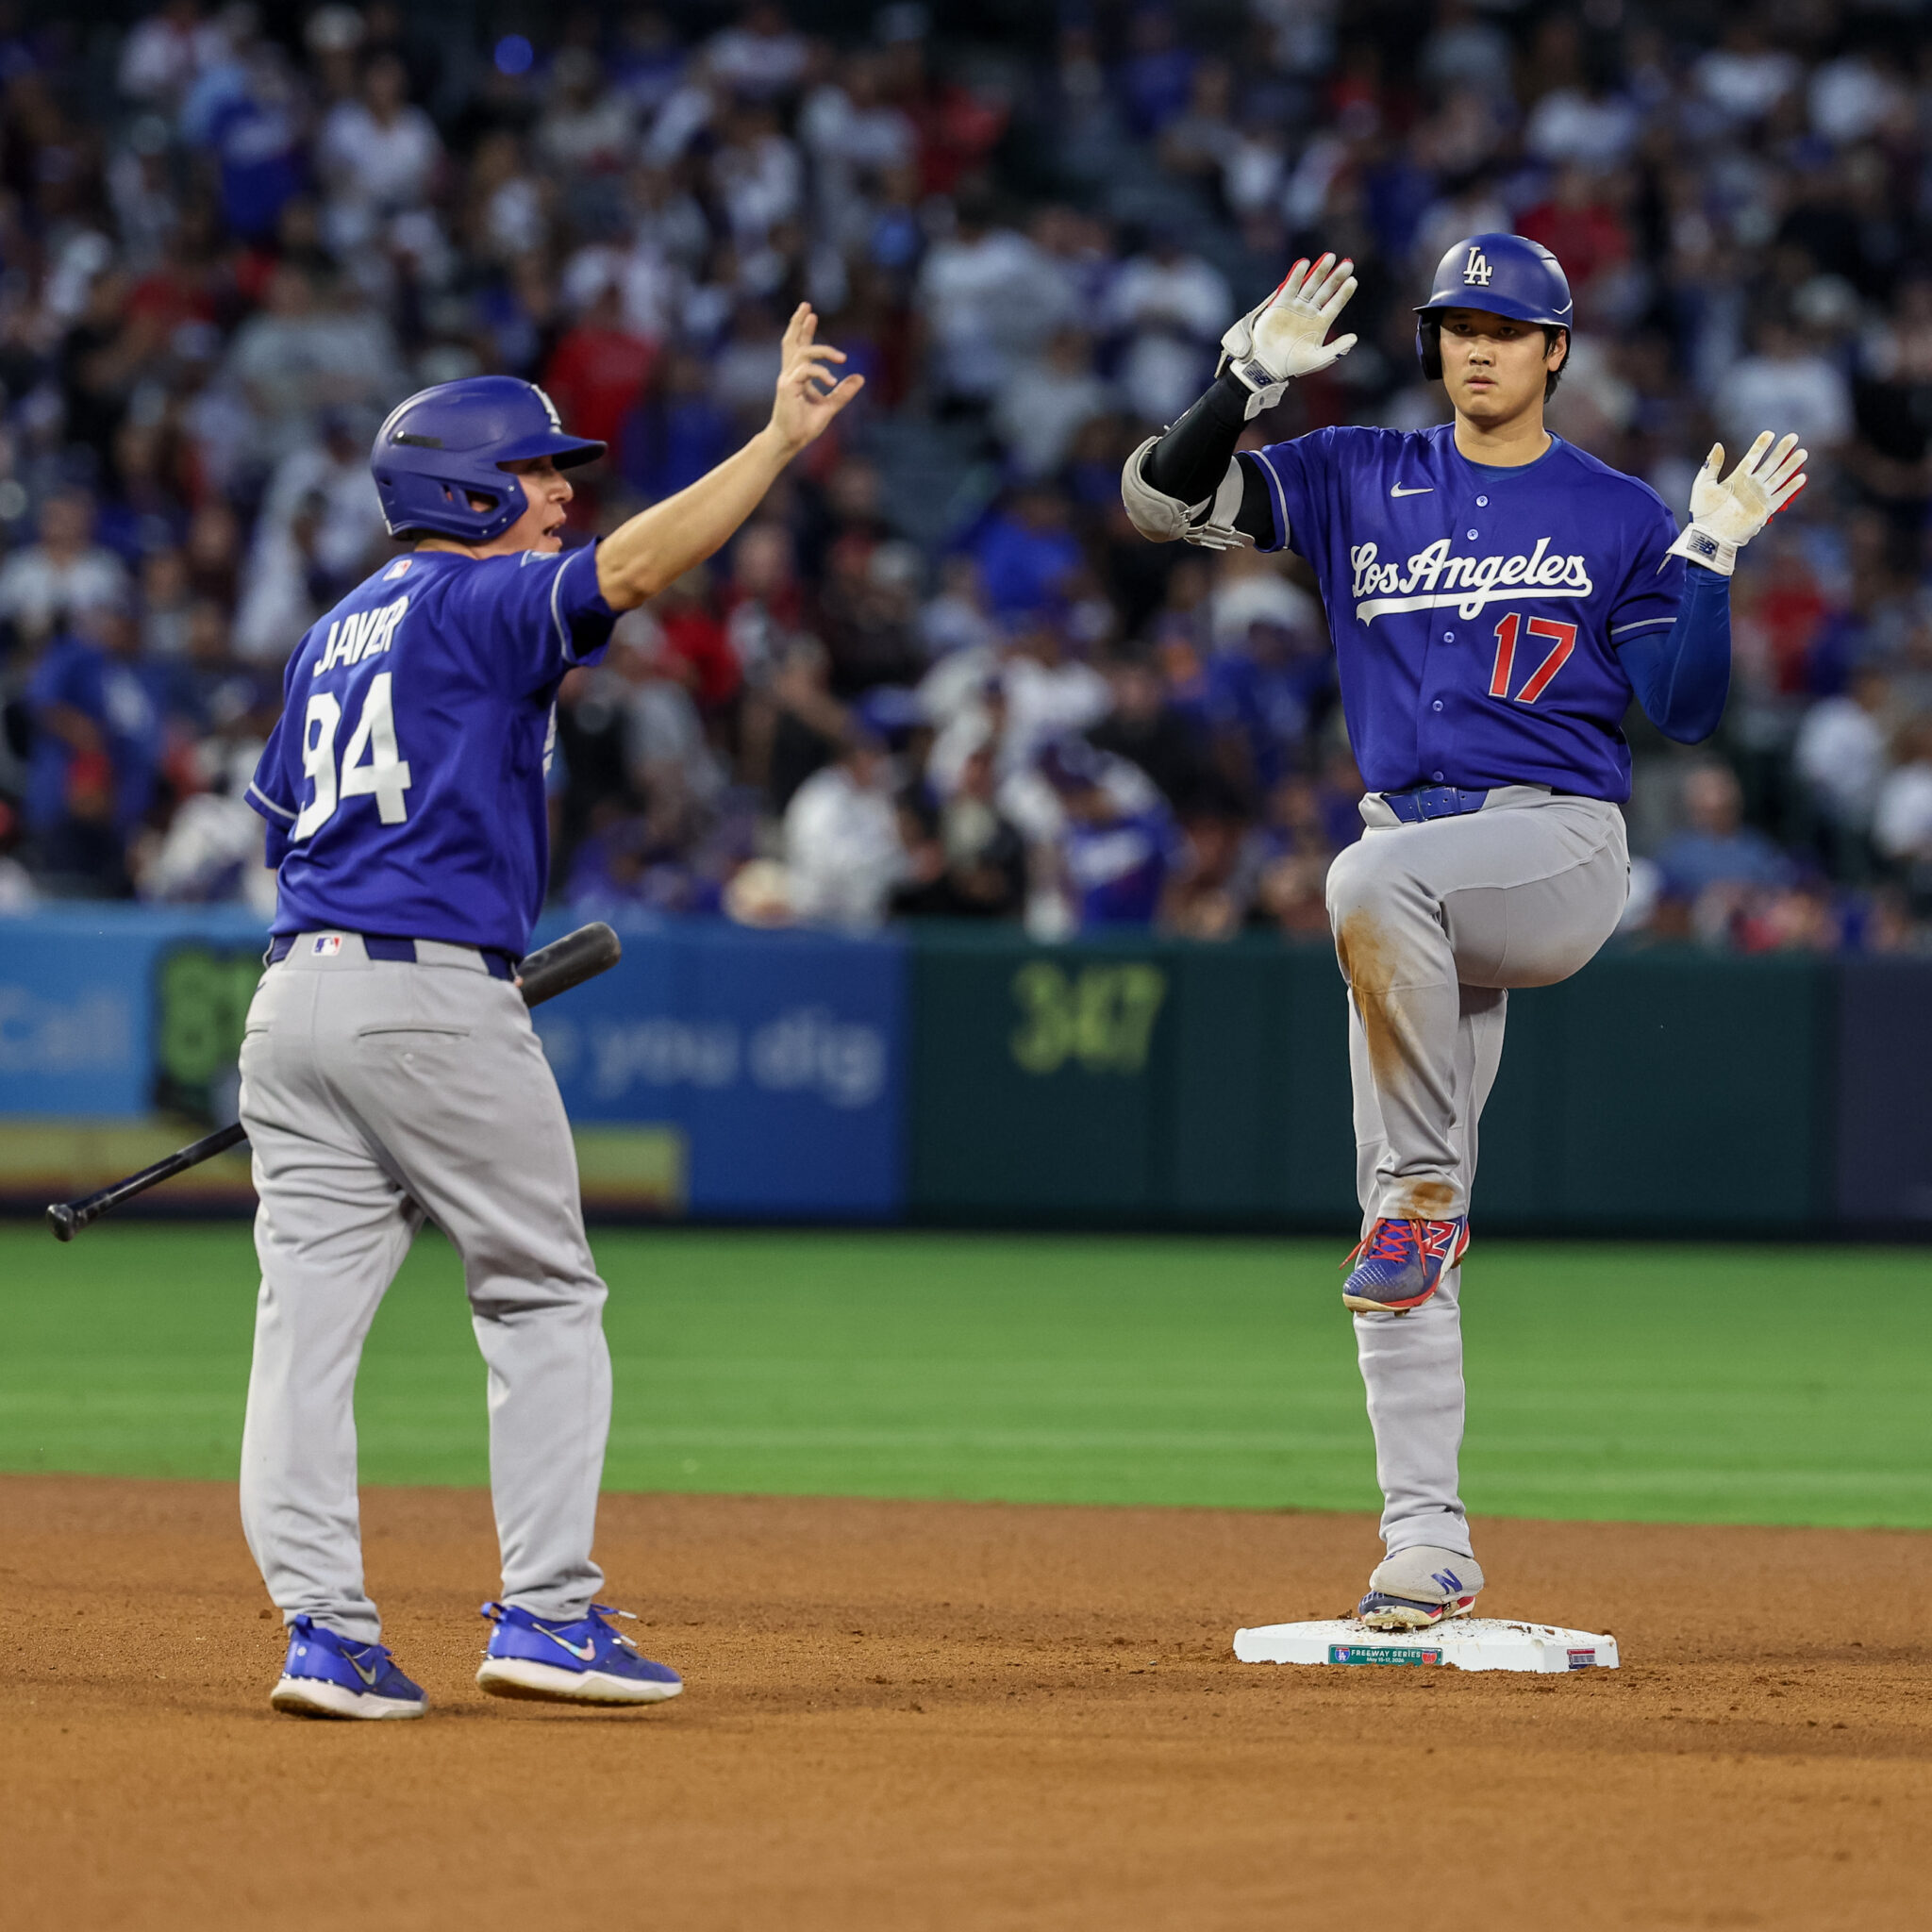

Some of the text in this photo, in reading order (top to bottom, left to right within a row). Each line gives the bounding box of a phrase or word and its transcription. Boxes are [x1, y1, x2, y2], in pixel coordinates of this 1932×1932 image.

[1463, 246, 1493, 287] LA
[1350, 537, 1592, 621] Los Angeles
[1489, 612, 1578, 705] 17
[294, 672, 412, 842] 94
[1431, 1568, 1463, 1594] N
[1351, 1649, 1390, 1657] FREEWAY
[1392, 1650, 1421, 1658] SERIES
